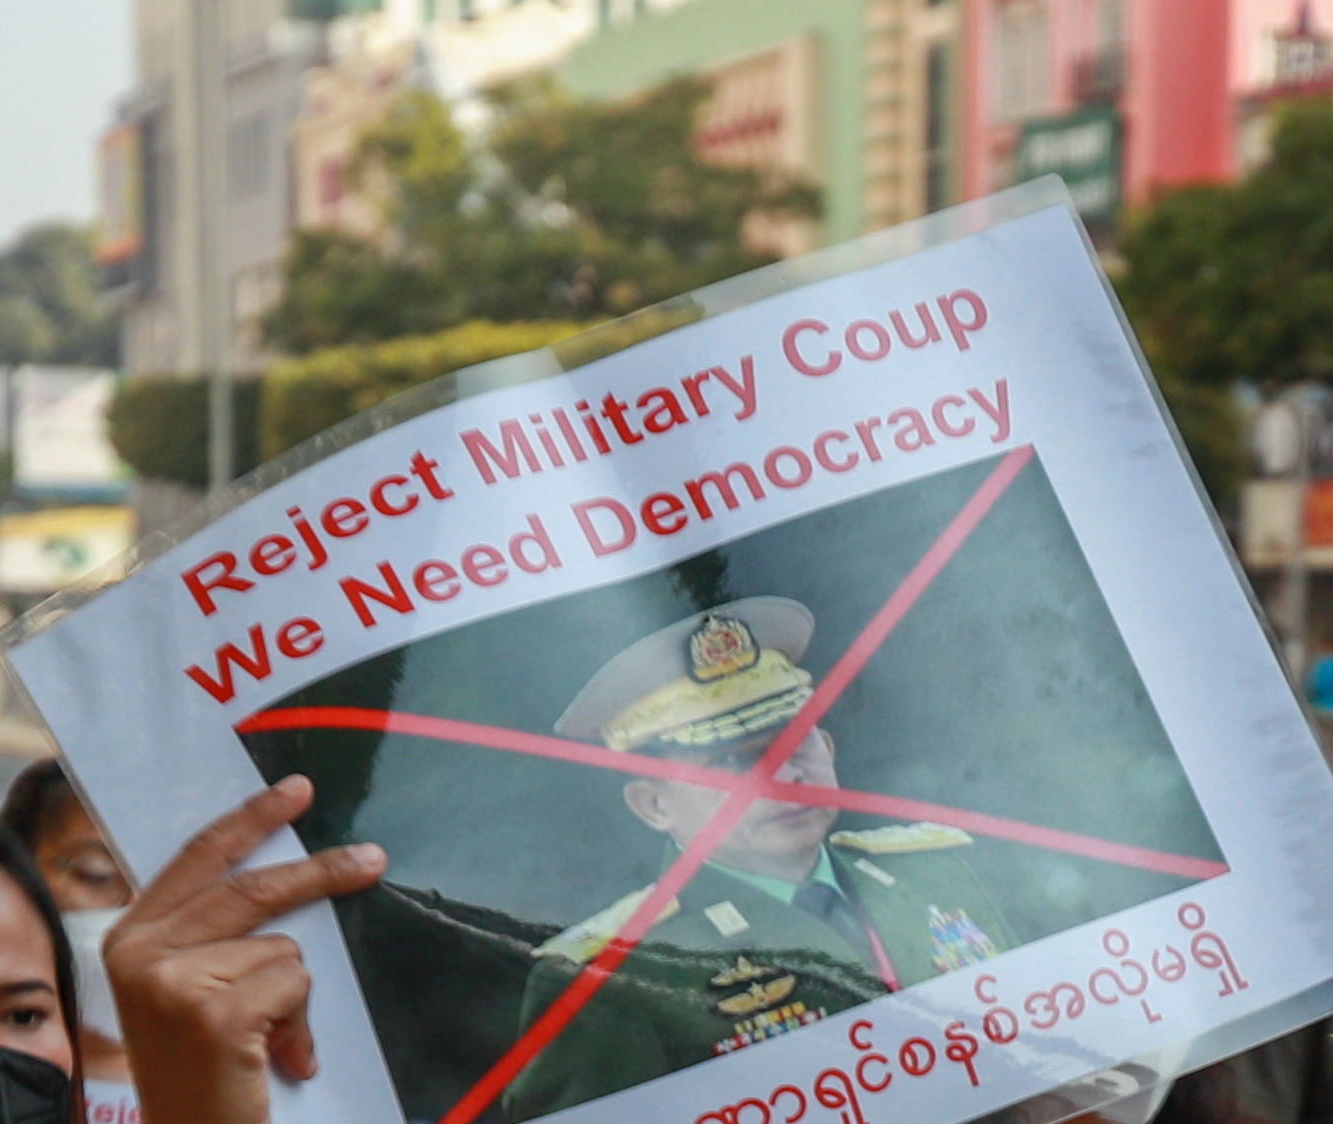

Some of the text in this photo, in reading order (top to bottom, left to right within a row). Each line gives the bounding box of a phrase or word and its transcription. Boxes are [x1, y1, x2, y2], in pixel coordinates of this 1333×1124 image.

[179, 286, 990, 618] Reject Military Coup
[184, 378, 1011, 706] We Need Democracy
